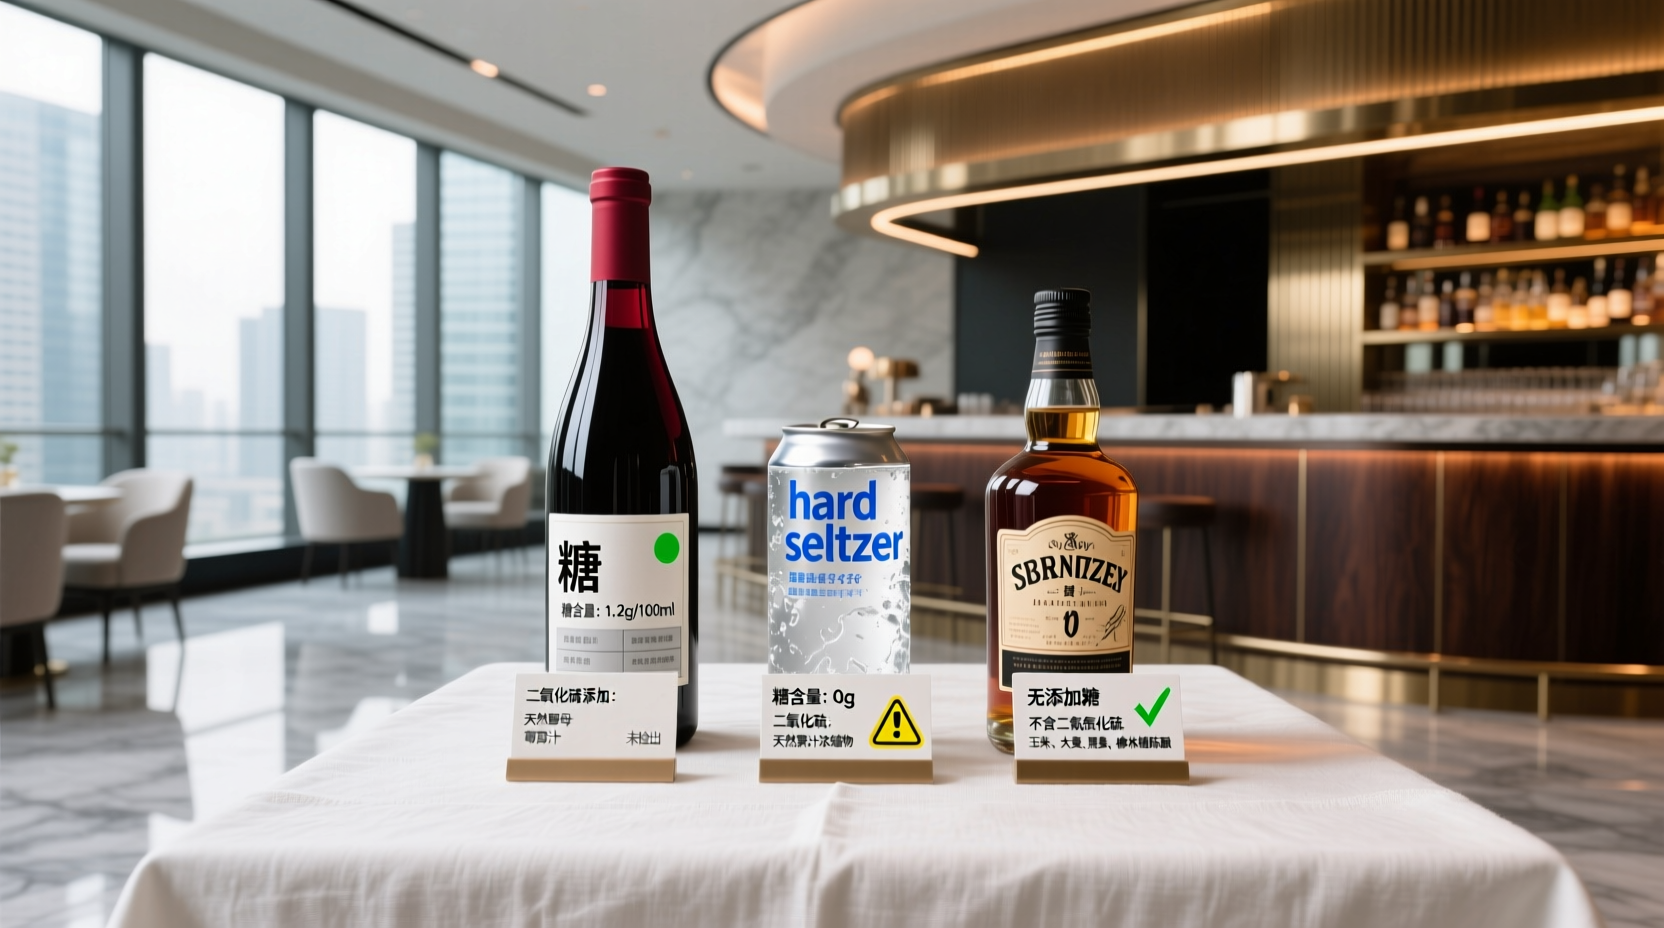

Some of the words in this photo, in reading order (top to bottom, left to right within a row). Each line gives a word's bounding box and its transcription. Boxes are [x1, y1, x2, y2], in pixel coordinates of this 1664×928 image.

[789, 479, 877, 521] hard
[785, 523, 904, 563] seltzer
[558, 540, 602, 594] 糖
[1027, 686, 1101, 707] 无添加糖
